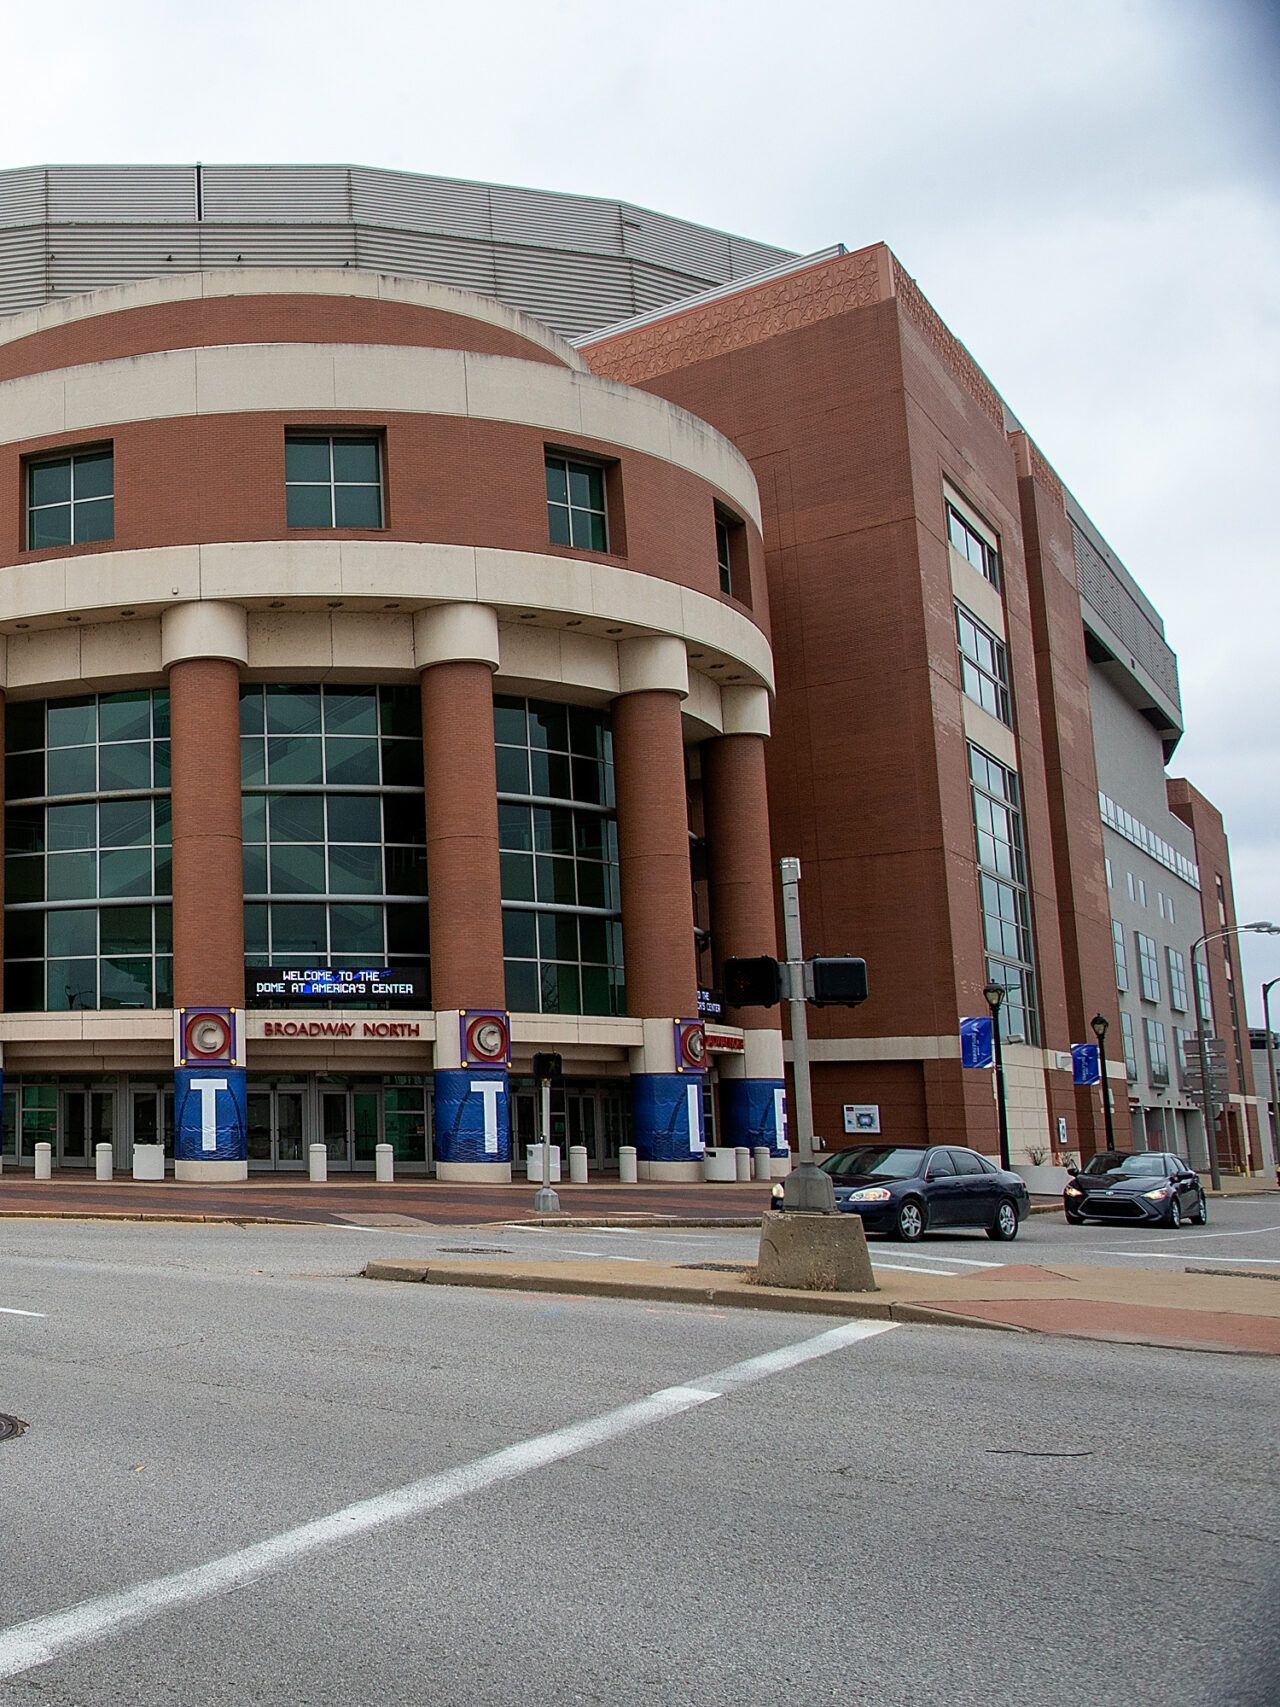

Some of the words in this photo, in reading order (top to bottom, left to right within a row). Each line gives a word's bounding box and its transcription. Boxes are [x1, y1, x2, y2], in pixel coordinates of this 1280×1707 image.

[282, 971, 332, 981] WELCOME
[338, 971, 353, 981] TO
[359, 971, 380, 982] THE
[256, 983, 286, 993] DOME
[291, 983, 306, 993] AT
[311, 983, 366, 994] AMERICA'S
[372, 984, 414, 994] CENTER
[198, 1023, 218, 1050] C
[264, 1022, 356, 1037] BROADWAY
[363, 1023, 420, 1037] NORTH
[477, 1024, 499, 1051] C
[190, 1079, 228, 1151] T
[470, 1081, 504, 1153] T
[687, 1084, 706, 1152] L
